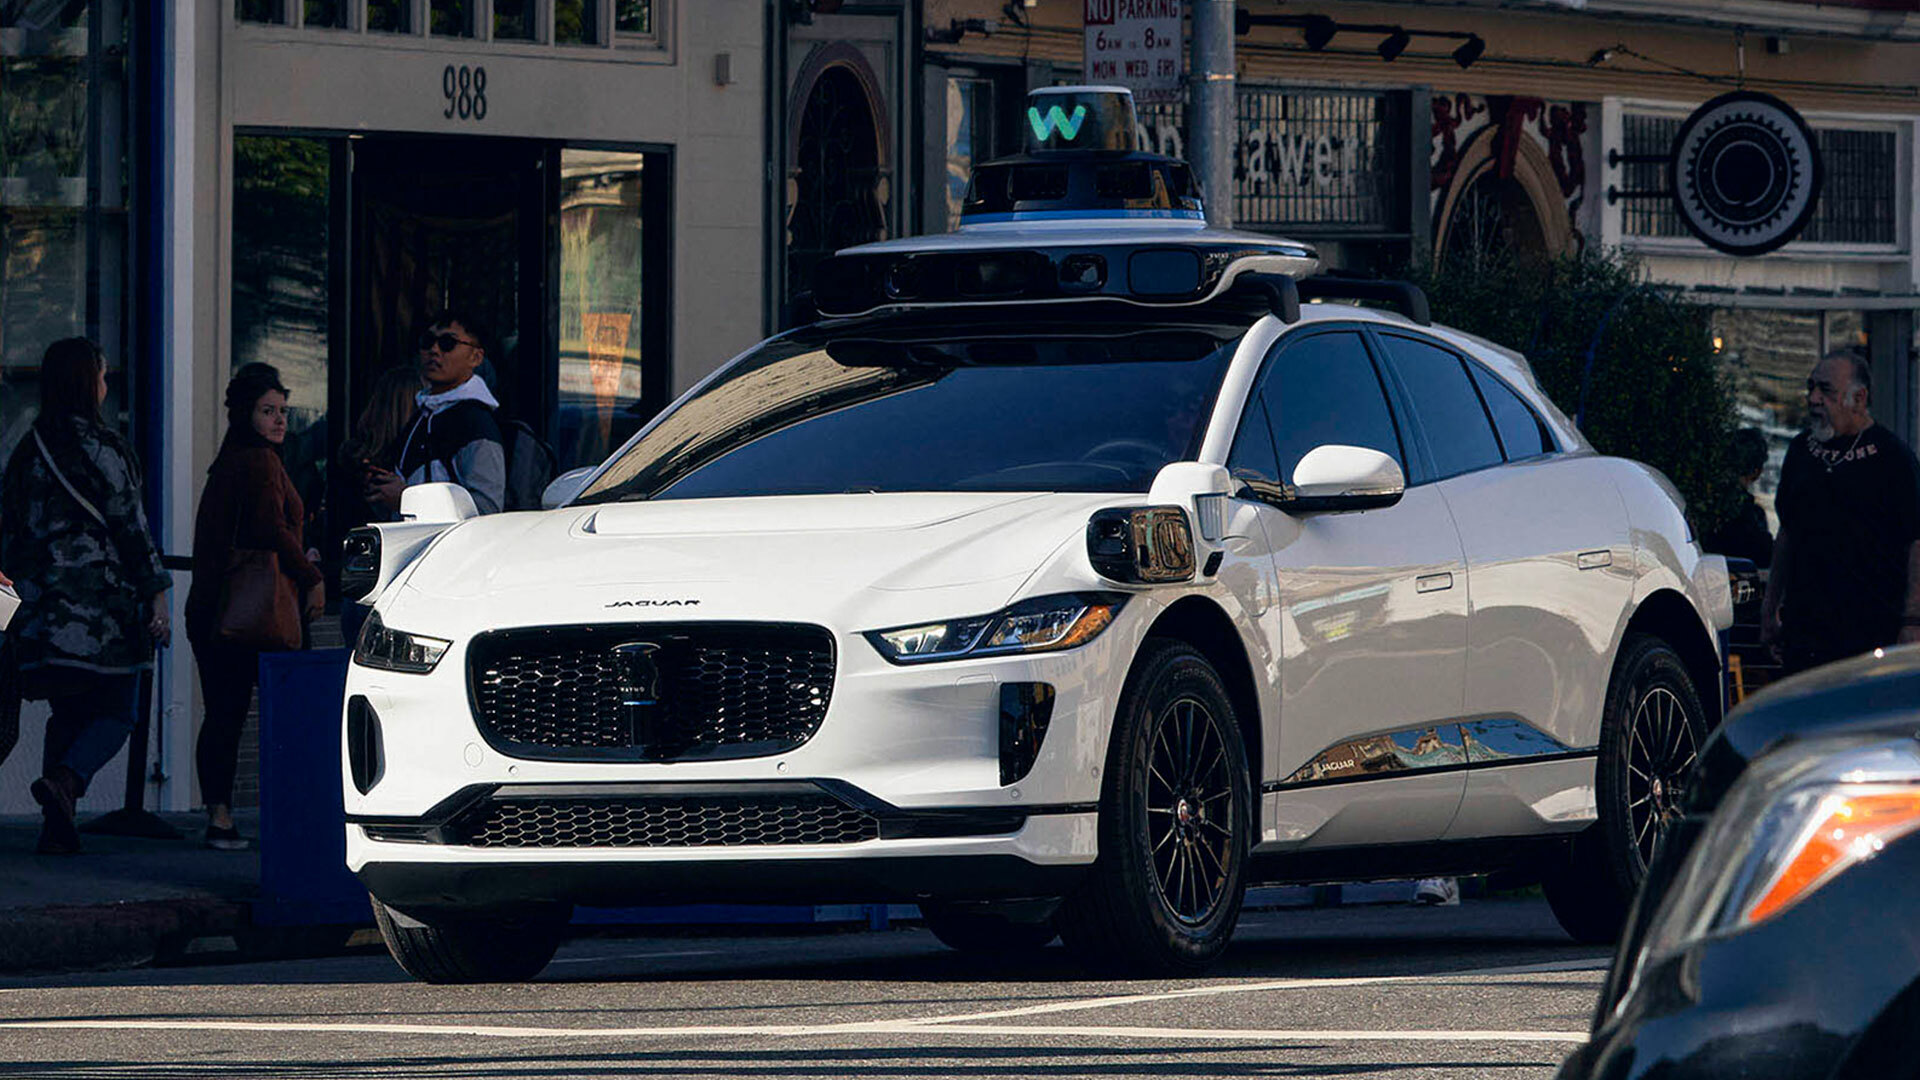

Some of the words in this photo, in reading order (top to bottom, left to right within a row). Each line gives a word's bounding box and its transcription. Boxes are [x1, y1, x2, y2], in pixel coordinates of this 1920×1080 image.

[1086, 0, 1112, 21] NO
[1118, 0, 1178, 19] PARKING
[1096, 30, 1122, 51] 6AM
[1144, 27, 1171, 49] 8AM
[1092, 60, 1116, 79] MON
[1125, 59, 1149, 77] WED
[1157, 58, 1175, 77] FRI
[443, 64, 487, 120] 988
[605, 600, 700, 608] JAGUAR
[1321, 759, 1355, 773] JAGUAR
